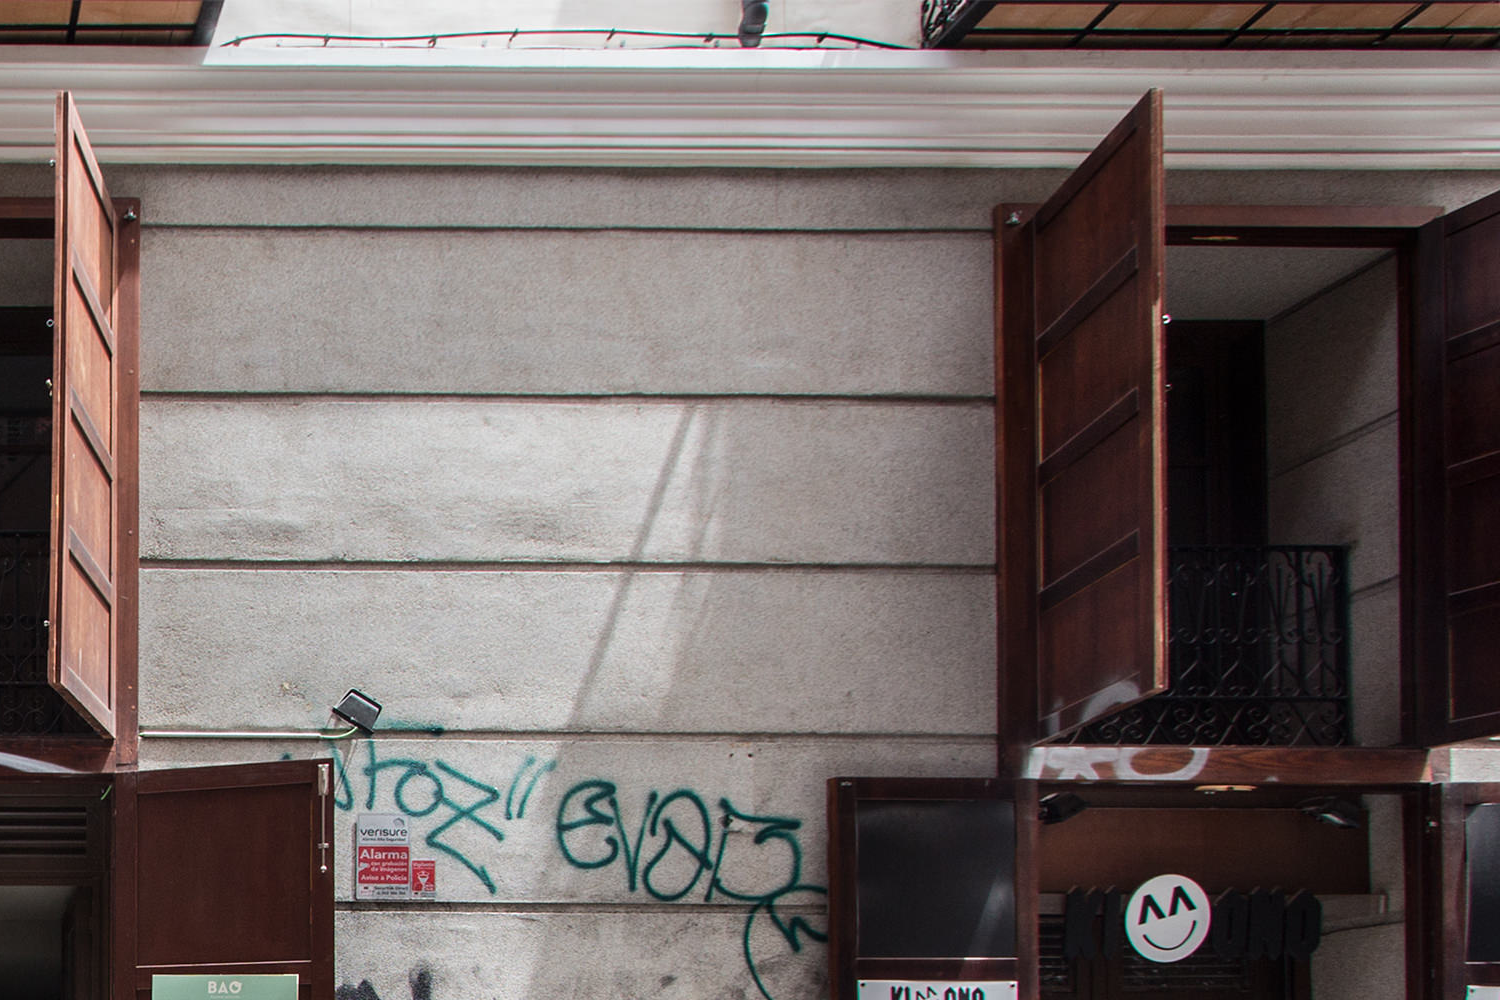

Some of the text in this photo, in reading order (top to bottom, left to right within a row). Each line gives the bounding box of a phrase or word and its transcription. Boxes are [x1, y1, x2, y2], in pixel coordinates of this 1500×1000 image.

[360, 828, 408, 837] verisure
[360, 848, 408, 860] Alarma
[207, 981, 243, 994] BAO
